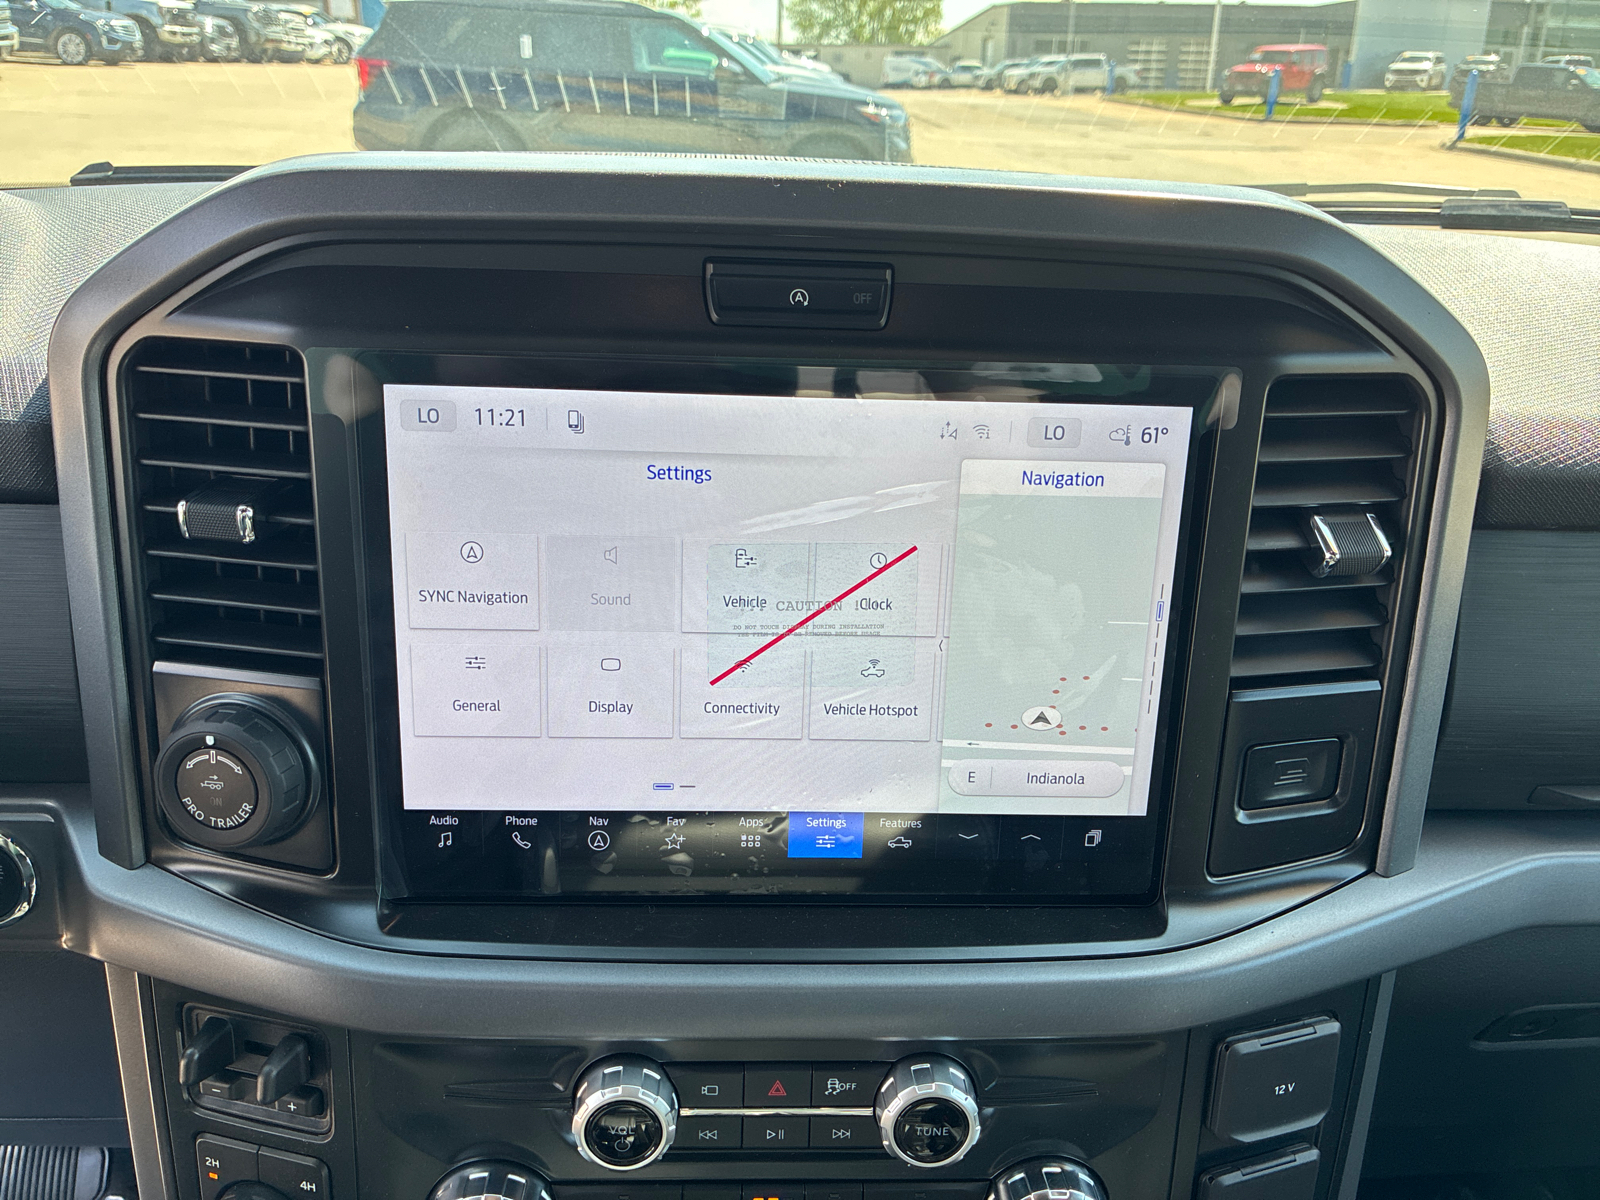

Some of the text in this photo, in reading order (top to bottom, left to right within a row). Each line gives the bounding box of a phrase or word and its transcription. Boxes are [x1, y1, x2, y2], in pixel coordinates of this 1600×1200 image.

[853, 292, 872, 304] OFF
[417, 407, 440, 424] LO
[474, 408, 526, 427] 11:21
[1043, 425, 1065, 441] LO
[1140, 427, 1169, 444] 61°
[646, 464, 713, 484] Settings
[1021, 470, 1105, 489] Navigation
[418, 590, 529, 605] SYNC Navigation
[590, 593, 632, 606] Sound
[722, 595, 767, 608] Vehicle
[859, 597, 893, 611] Clock
[775, 600, 843, 612] CAUTION
[452, 699, 501, 712] General
[588, 700, 634, 715] Display
[703, 701, 780, 717] Connectivity
[823, 703, 919, 718] Vehicle Hotspot
[967, 771, 976, 784] E
[1026, 772, 1085, 785] Indianola
[182, 797, 254, 829] PRO TRAILER
[429, 815, 459, 826] Audio
[505, 815, 538, 827] Phone
[589, 816, 609, 827] Nav
[666, 816, 686, 827] Fav
[739, 816, 764, 829] Apps
[806, 816, 847, 829] Settings
[879, 817, 922, 829] Features
[838, 1082, 857, 1091] OFF
[1274, 1082, 1296, 1095] 12 V
[608, 1125, 636, 1136] VOL
[916, 1126, 950, 1137] TUNE
[205, 1156, 220, 1169] 2H
[299, 1180, 316, 1193] 4H
